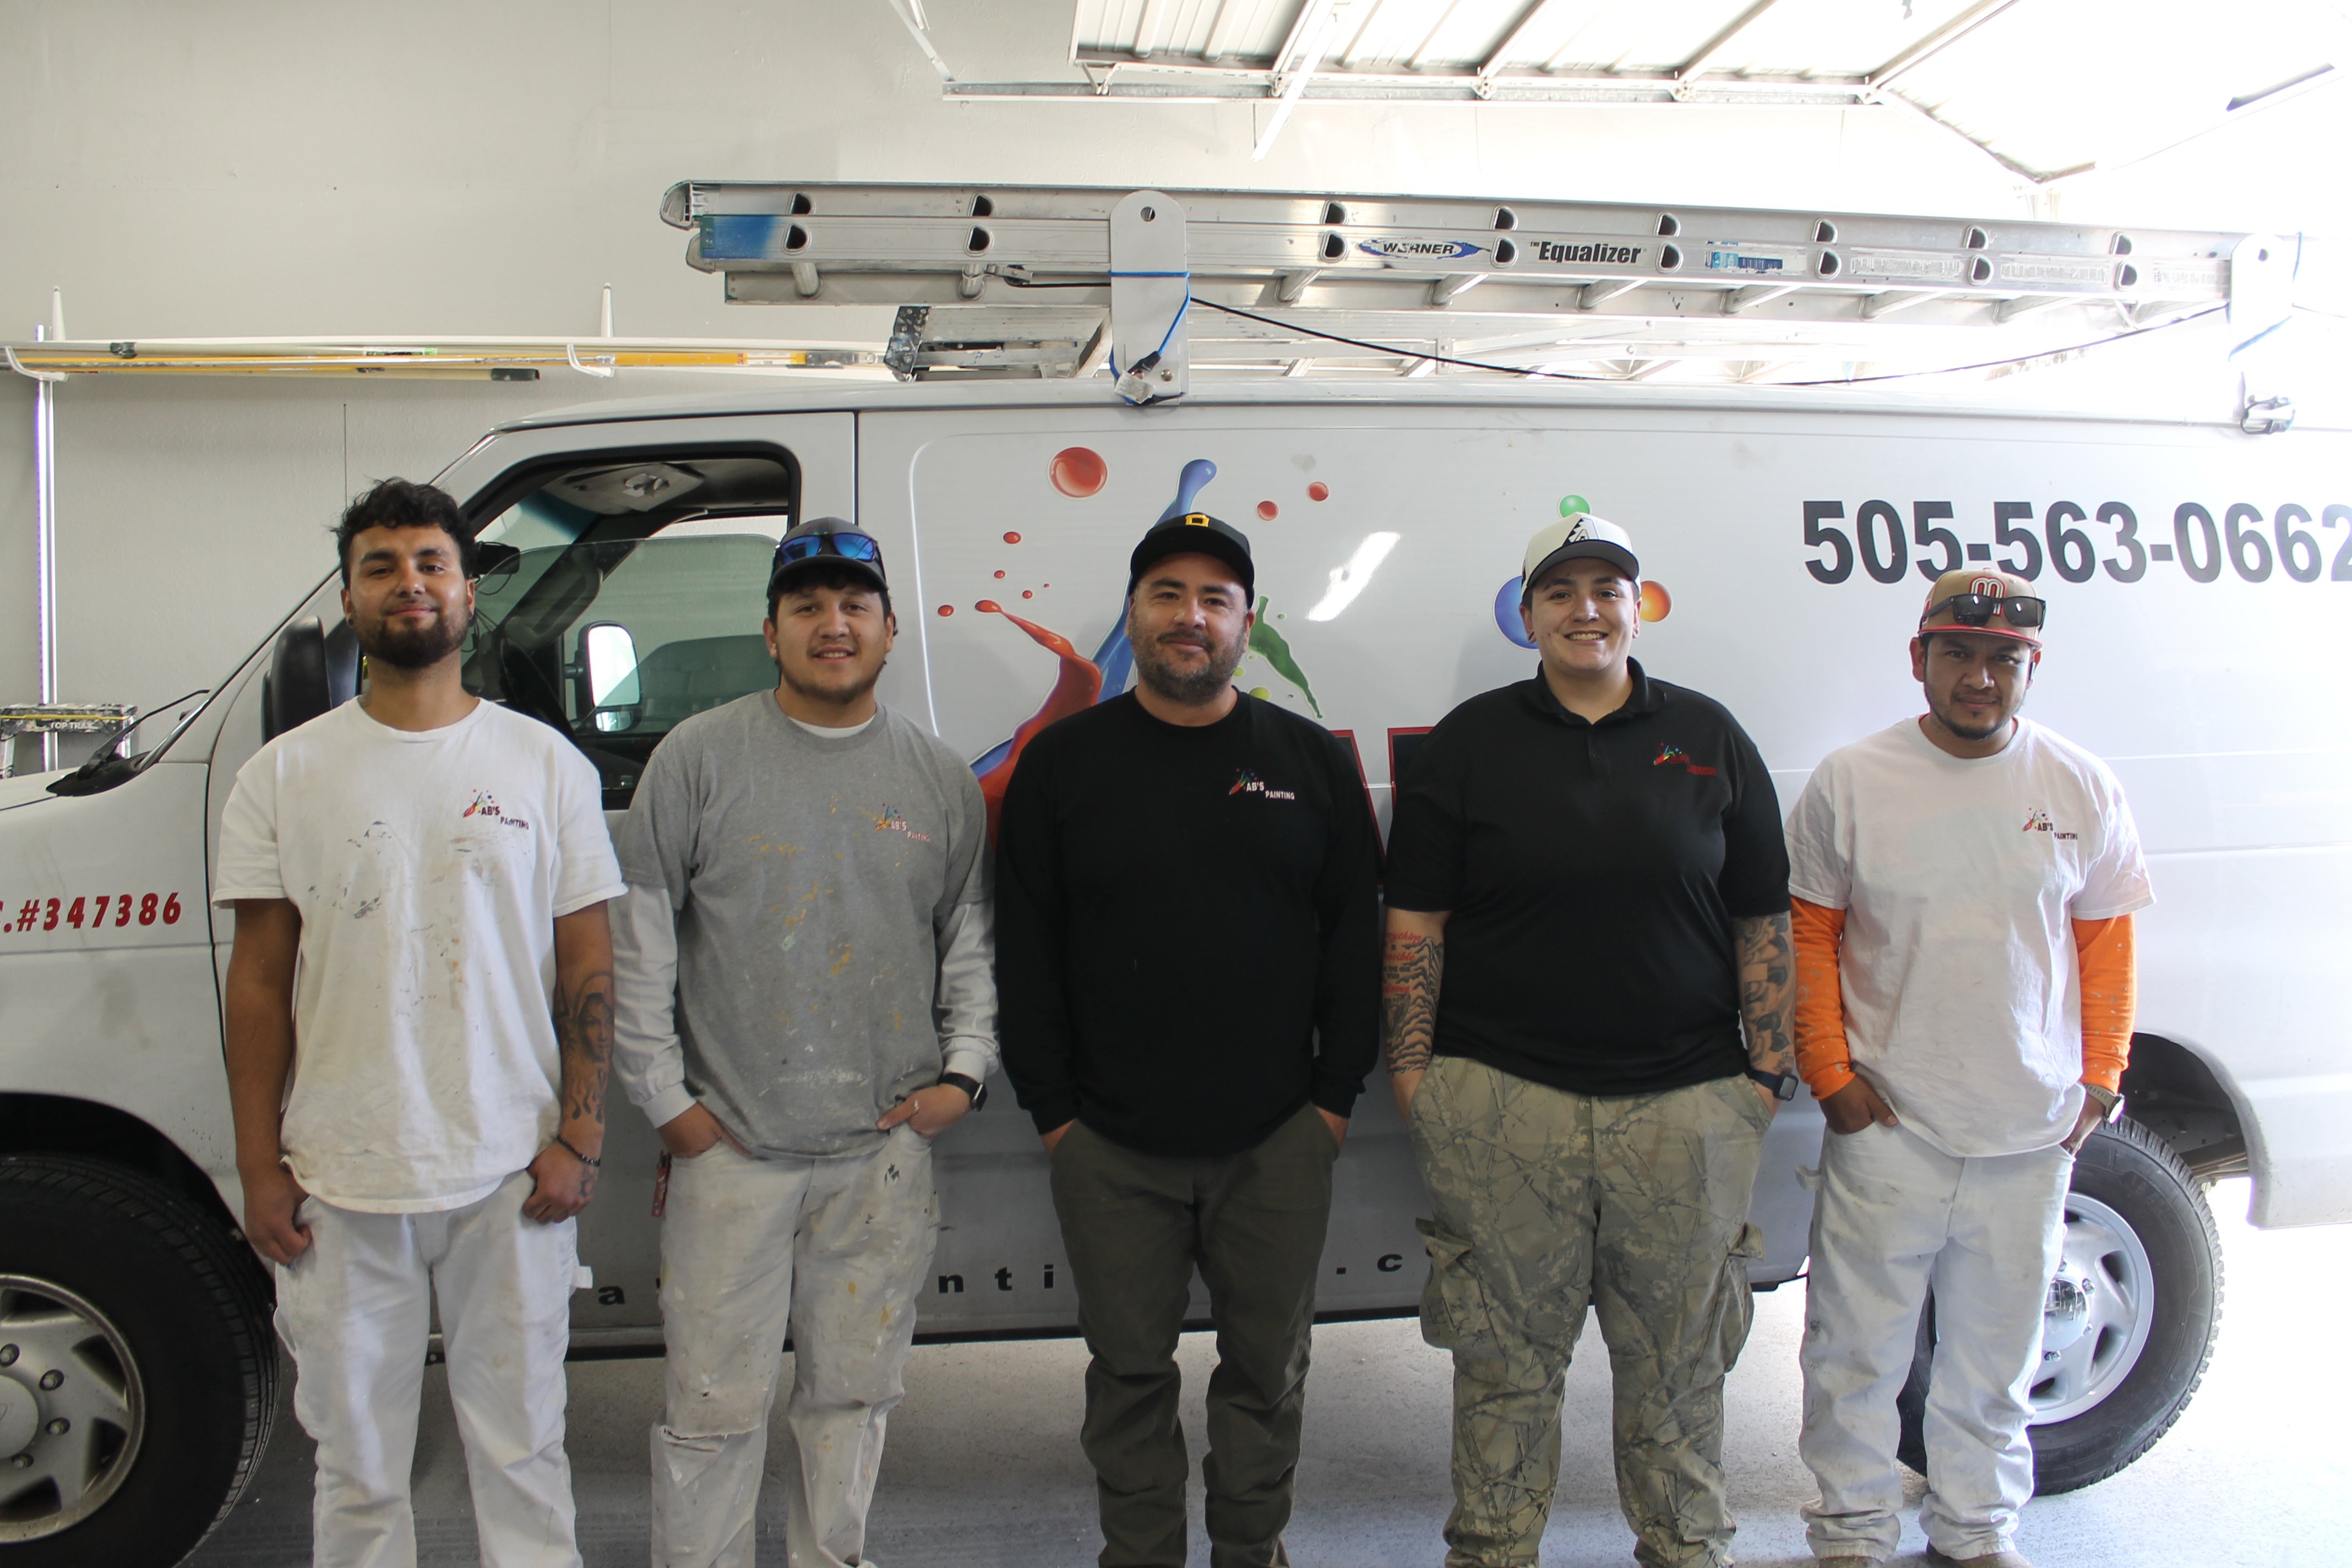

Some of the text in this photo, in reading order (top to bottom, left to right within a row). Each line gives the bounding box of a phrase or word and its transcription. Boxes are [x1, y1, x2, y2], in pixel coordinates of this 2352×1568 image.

[1383, 242, 1455, 254] WERNER
[1538, 241, 1642, 263] Equalizer
[1802, 499, 2352, 584] 505-563-0662
[51, 721, 68, 729] TOP
[1246, 781, 1265, 792] AB'S
[1265, 790, 1295, 800] PAINTING
[481, 806, 500, 816] AB'S
[500, 816, 529, 830] PAINTING
[891, 820, 907, 831] AB'S
[2037, 822, 2054, 831] AB'S
[0, 892, 182, 933] .#347386
